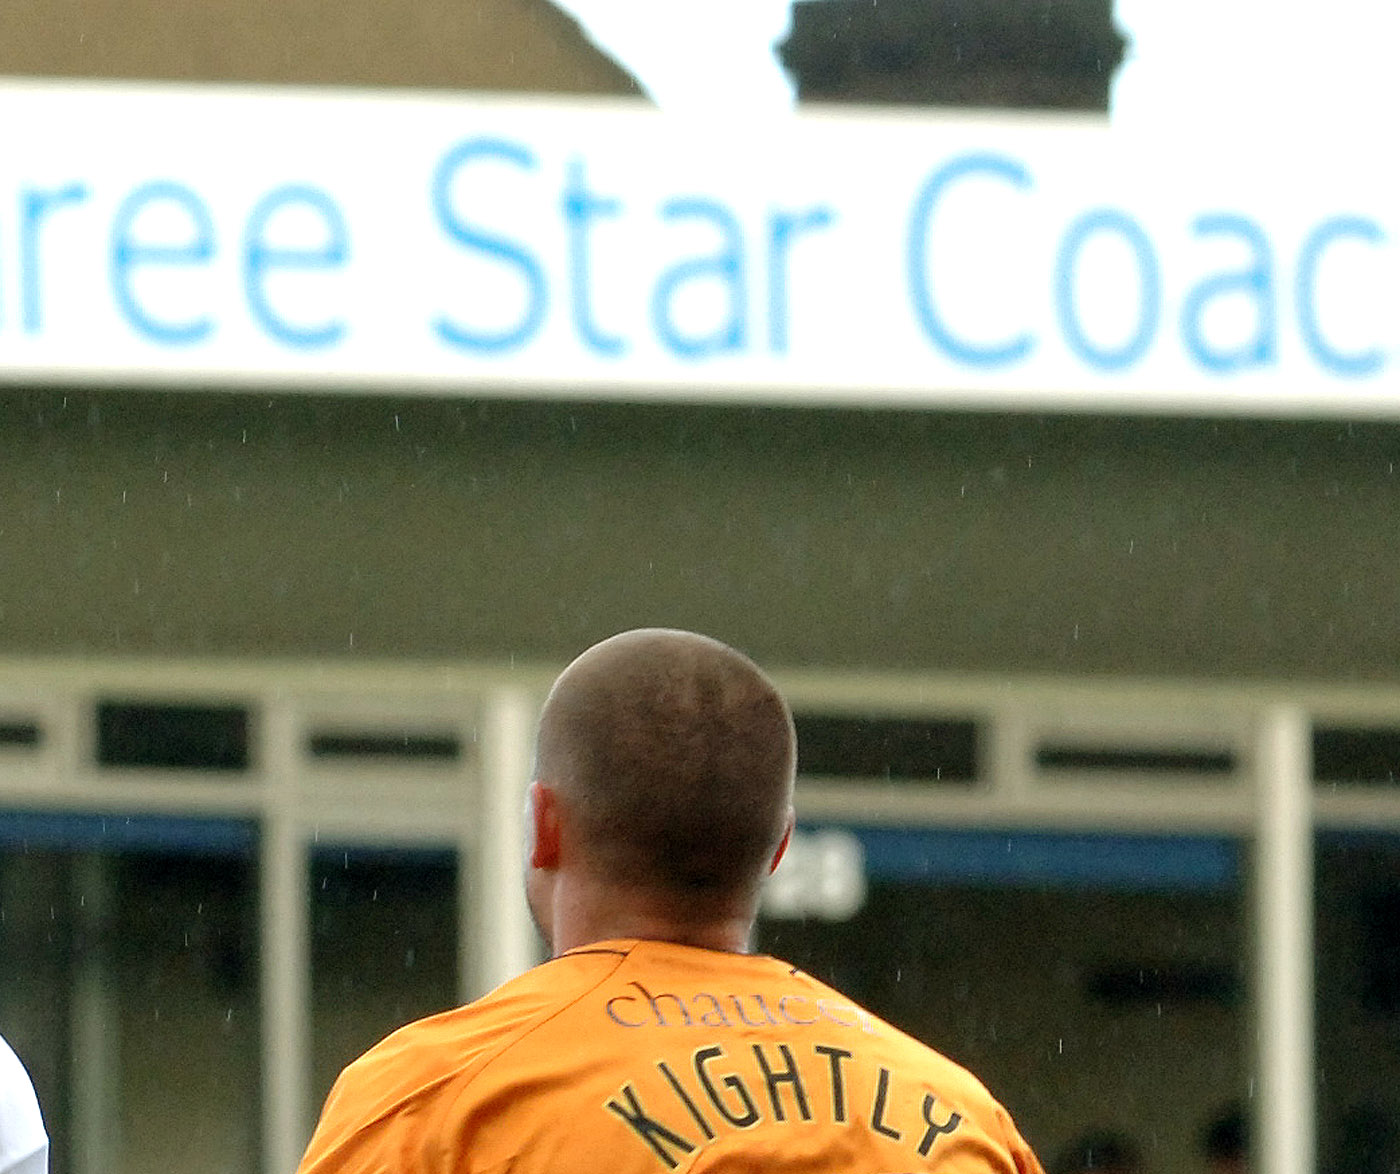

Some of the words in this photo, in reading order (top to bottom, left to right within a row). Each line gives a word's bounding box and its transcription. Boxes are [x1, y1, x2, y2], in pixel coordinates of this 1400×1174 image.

[431, 134, 836, 364] Star
[904, 146, 1388, 380] Coac
[607, 1043, 962, 1170] KIGHTLY
